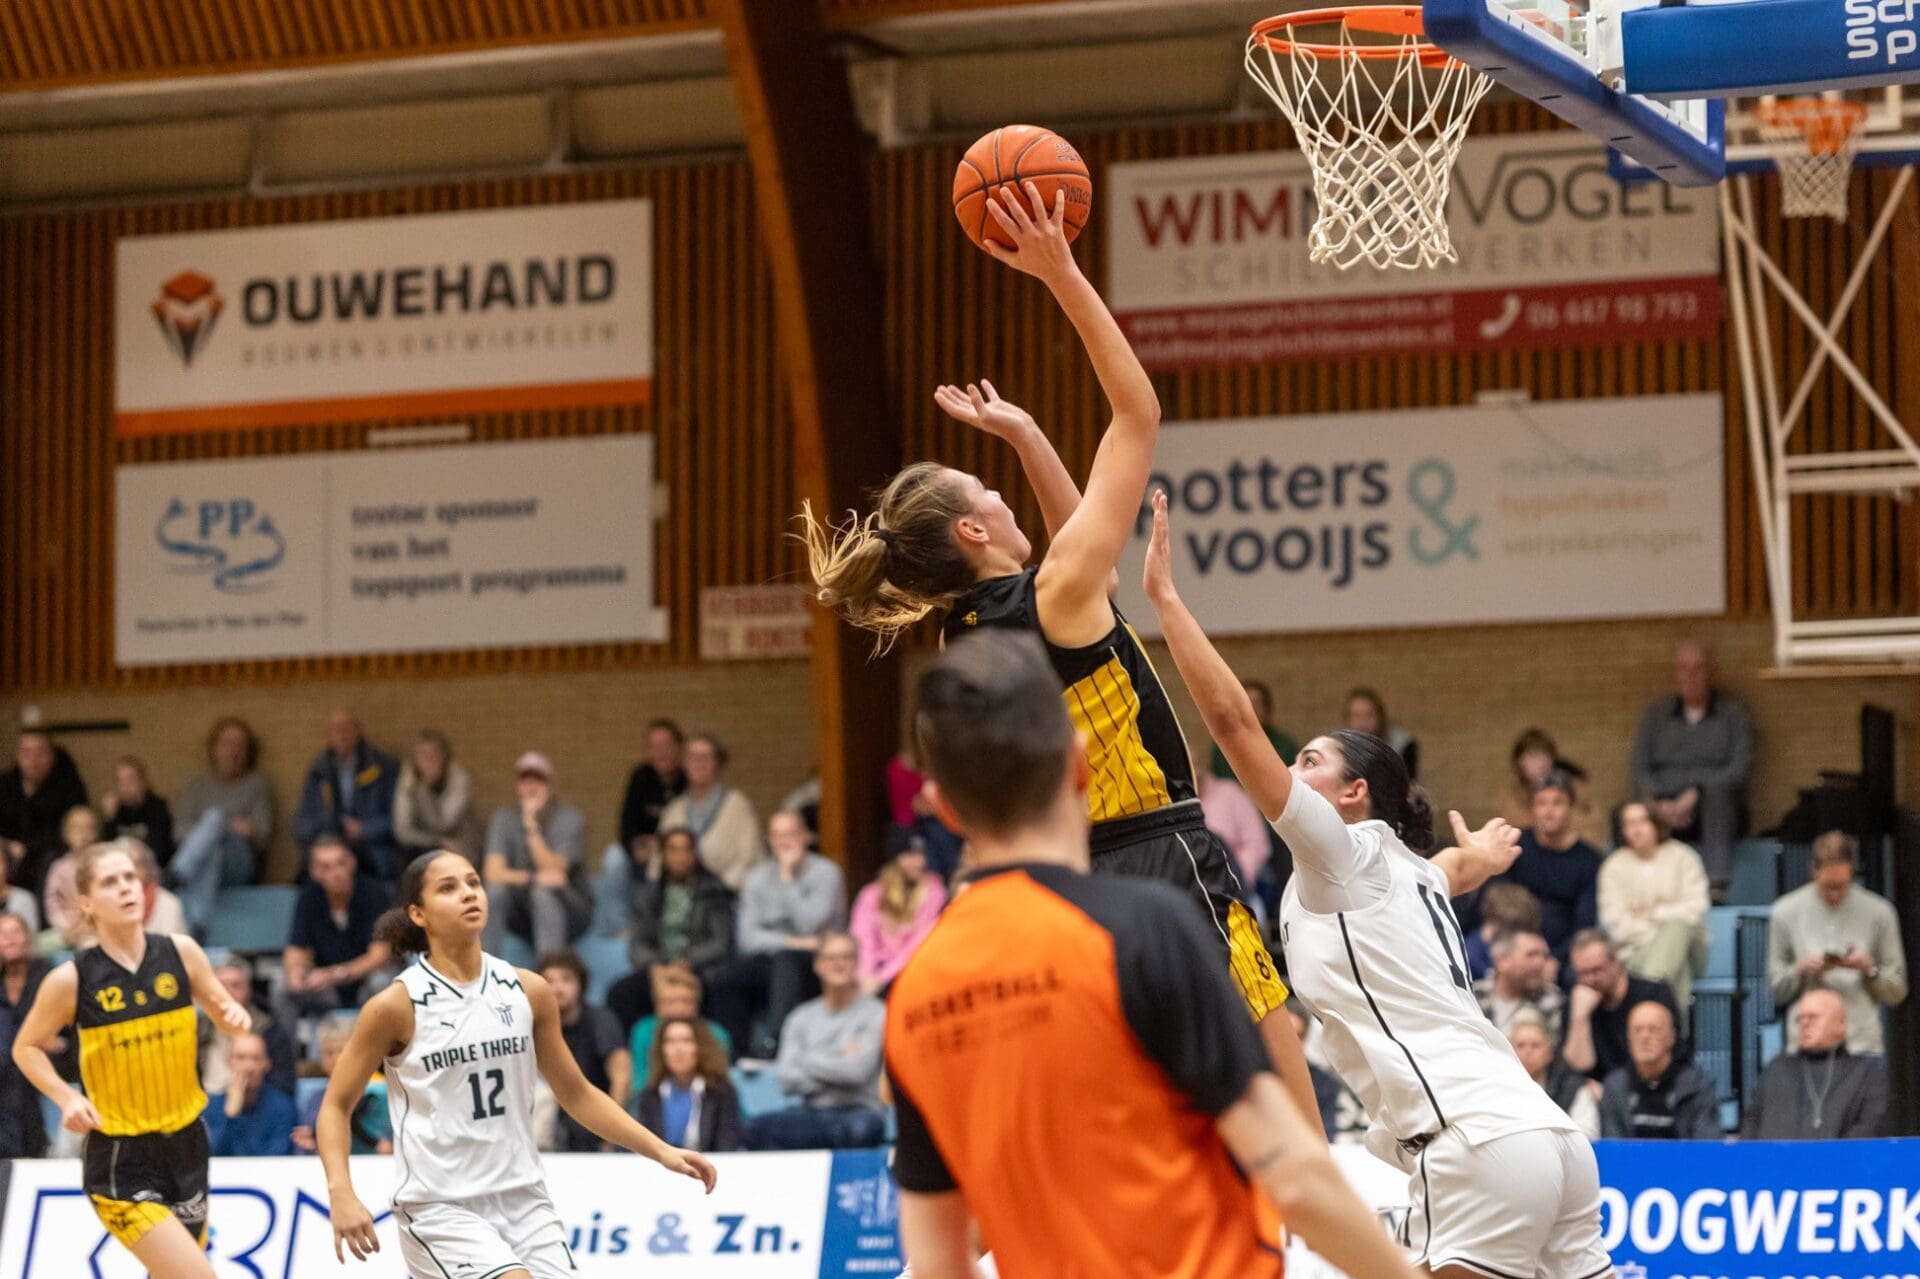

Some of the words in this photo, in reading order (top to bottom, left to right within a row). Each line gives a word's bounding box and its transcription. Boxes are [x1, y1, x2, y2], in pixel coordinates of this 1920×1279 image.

[1134, 184, 1292, 248] WIM
[242, 253, 617, 328] OUWEHAND
[1407, 458, 1481, 566] &
[1185, 520, 1392, 589] vooijs
[1254, 951, 1271, 981] 8
[95, 985, 127, 1012] 12
[420, 1043, 479, 1073] TRIPLE
[481, 1035, 529, 1060] THREA
[468, 1068, 506, 1121] 12
[647, 1211, 692, 1256] &
[712, 1213, 803, 1255] Zn.
